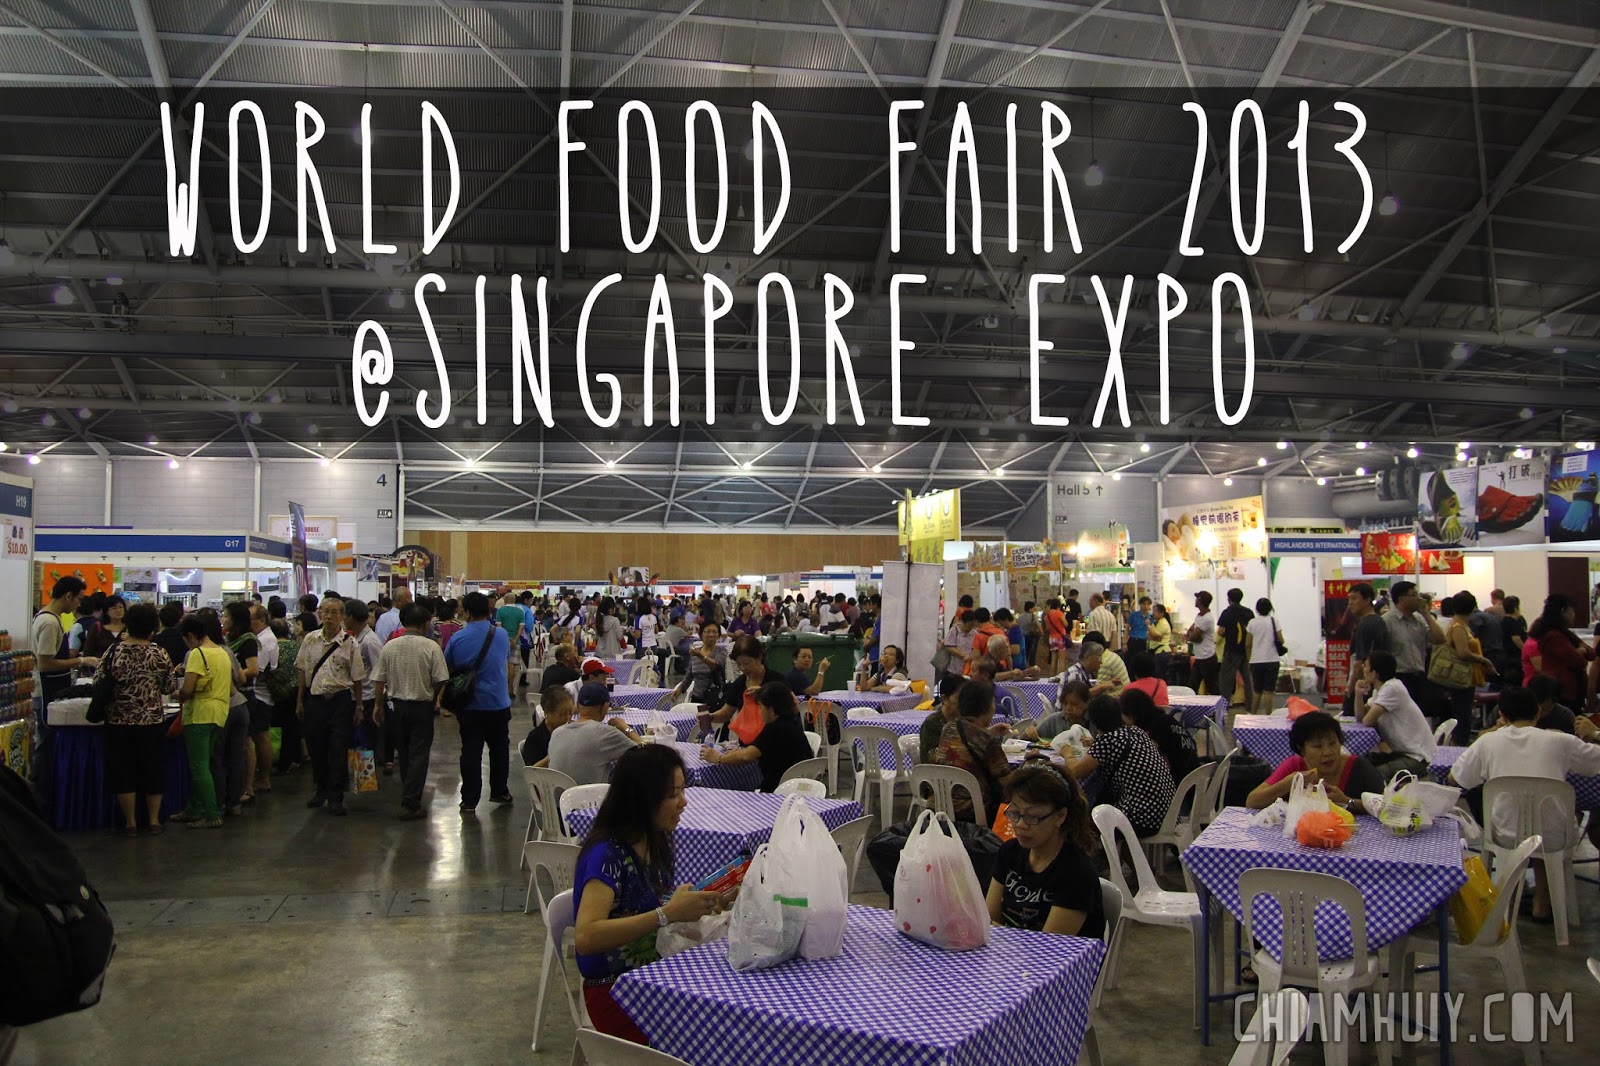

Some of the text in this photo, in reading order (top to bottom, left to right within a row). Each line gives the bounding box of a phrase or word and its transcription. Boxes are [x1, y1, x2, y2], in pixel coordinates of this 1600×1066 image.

[376, 473, 388, 487] 4
[1057, 484, 1080, 496] Hall
[15, 494, 27, 508] H19
[7, 542, 28, 555] $10.00
[225, 540, 240, 548] G17
[1274, 541, 1358, 549] HIGHLANDERS INTERNATIONAL
